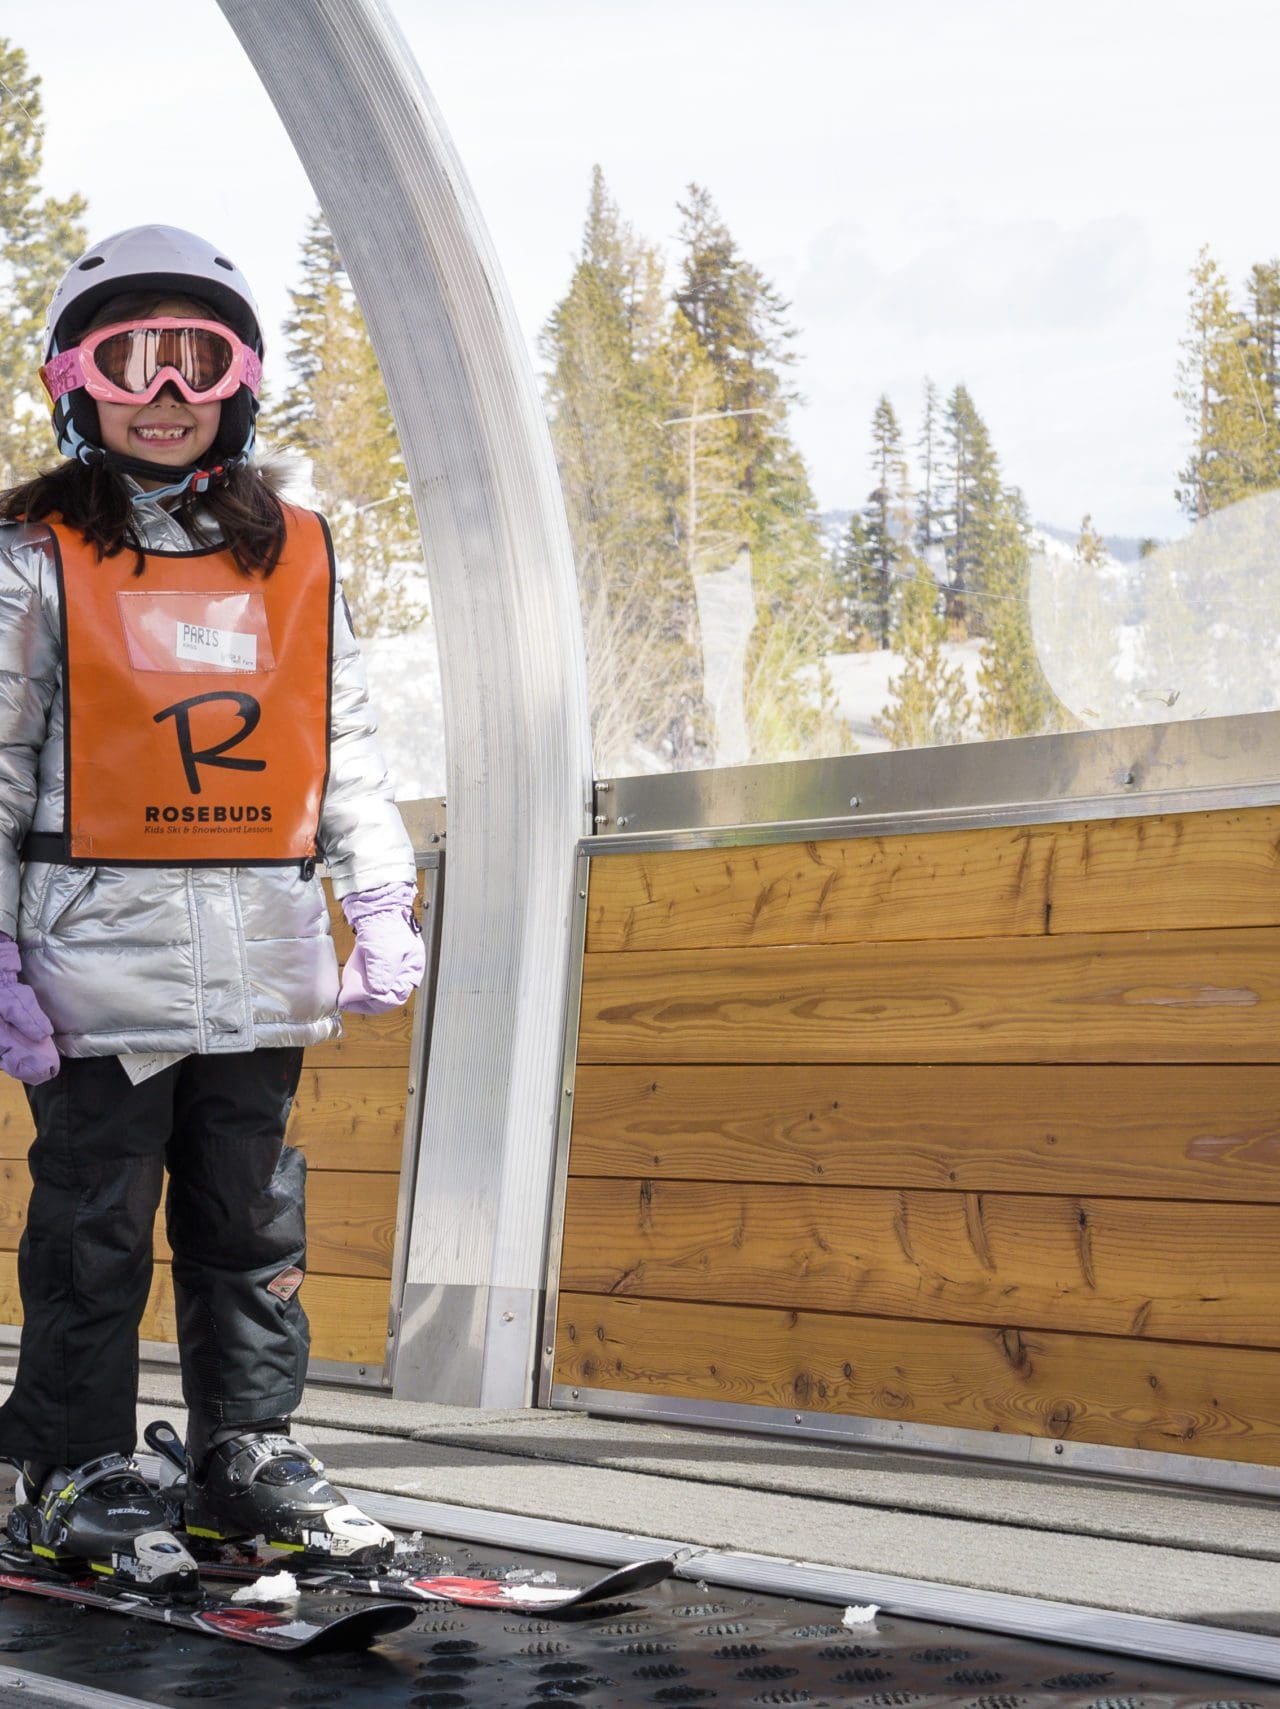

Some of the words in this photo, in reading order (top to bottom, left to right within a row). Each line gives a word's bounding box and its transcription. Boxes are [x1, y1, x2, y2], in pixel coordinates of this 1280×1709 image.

[183, 624, 219, 647] PARIS
[153, 690, 267, 795] R
[145, 806, 272, 822] ROSEBUDS
[144, 826, 164, 834] Kids
[167, 826, 181, 834] Ski
[183, 826, 189, 834] &
[192, 826, 241, 834] Snowboard
